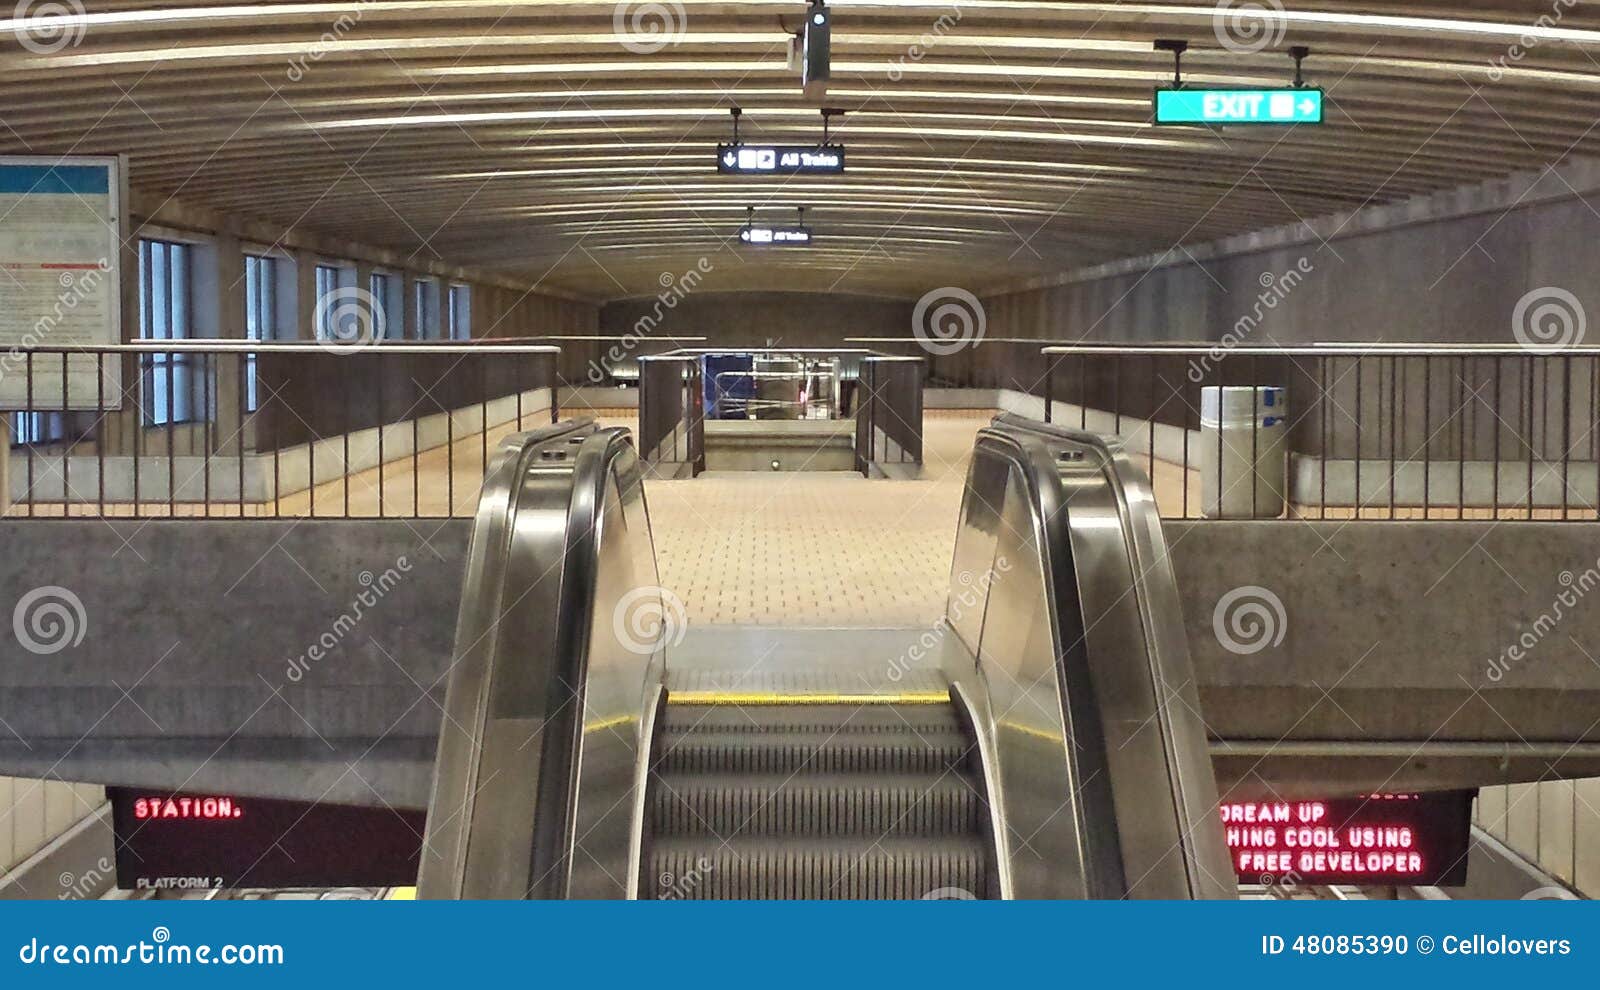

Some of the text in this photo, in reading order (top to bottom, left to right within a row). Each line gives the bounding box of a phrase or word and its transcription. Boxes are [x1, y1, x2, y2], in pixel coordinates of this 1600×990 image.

[1203, 94, 1265, 119] EXIT
[780, 152, 839, 167] All Trains
[135, 798, 242, 818] STATION.
[1299, 802, 1325, 822] UP
[1285, 827, 1340, 847] COOL
[1349, 827, 1412, 848] USING
[1239, 850, 1422, 872] FREE DEVELOPER
[136, 876, 224, 889] PLATFORM 2
